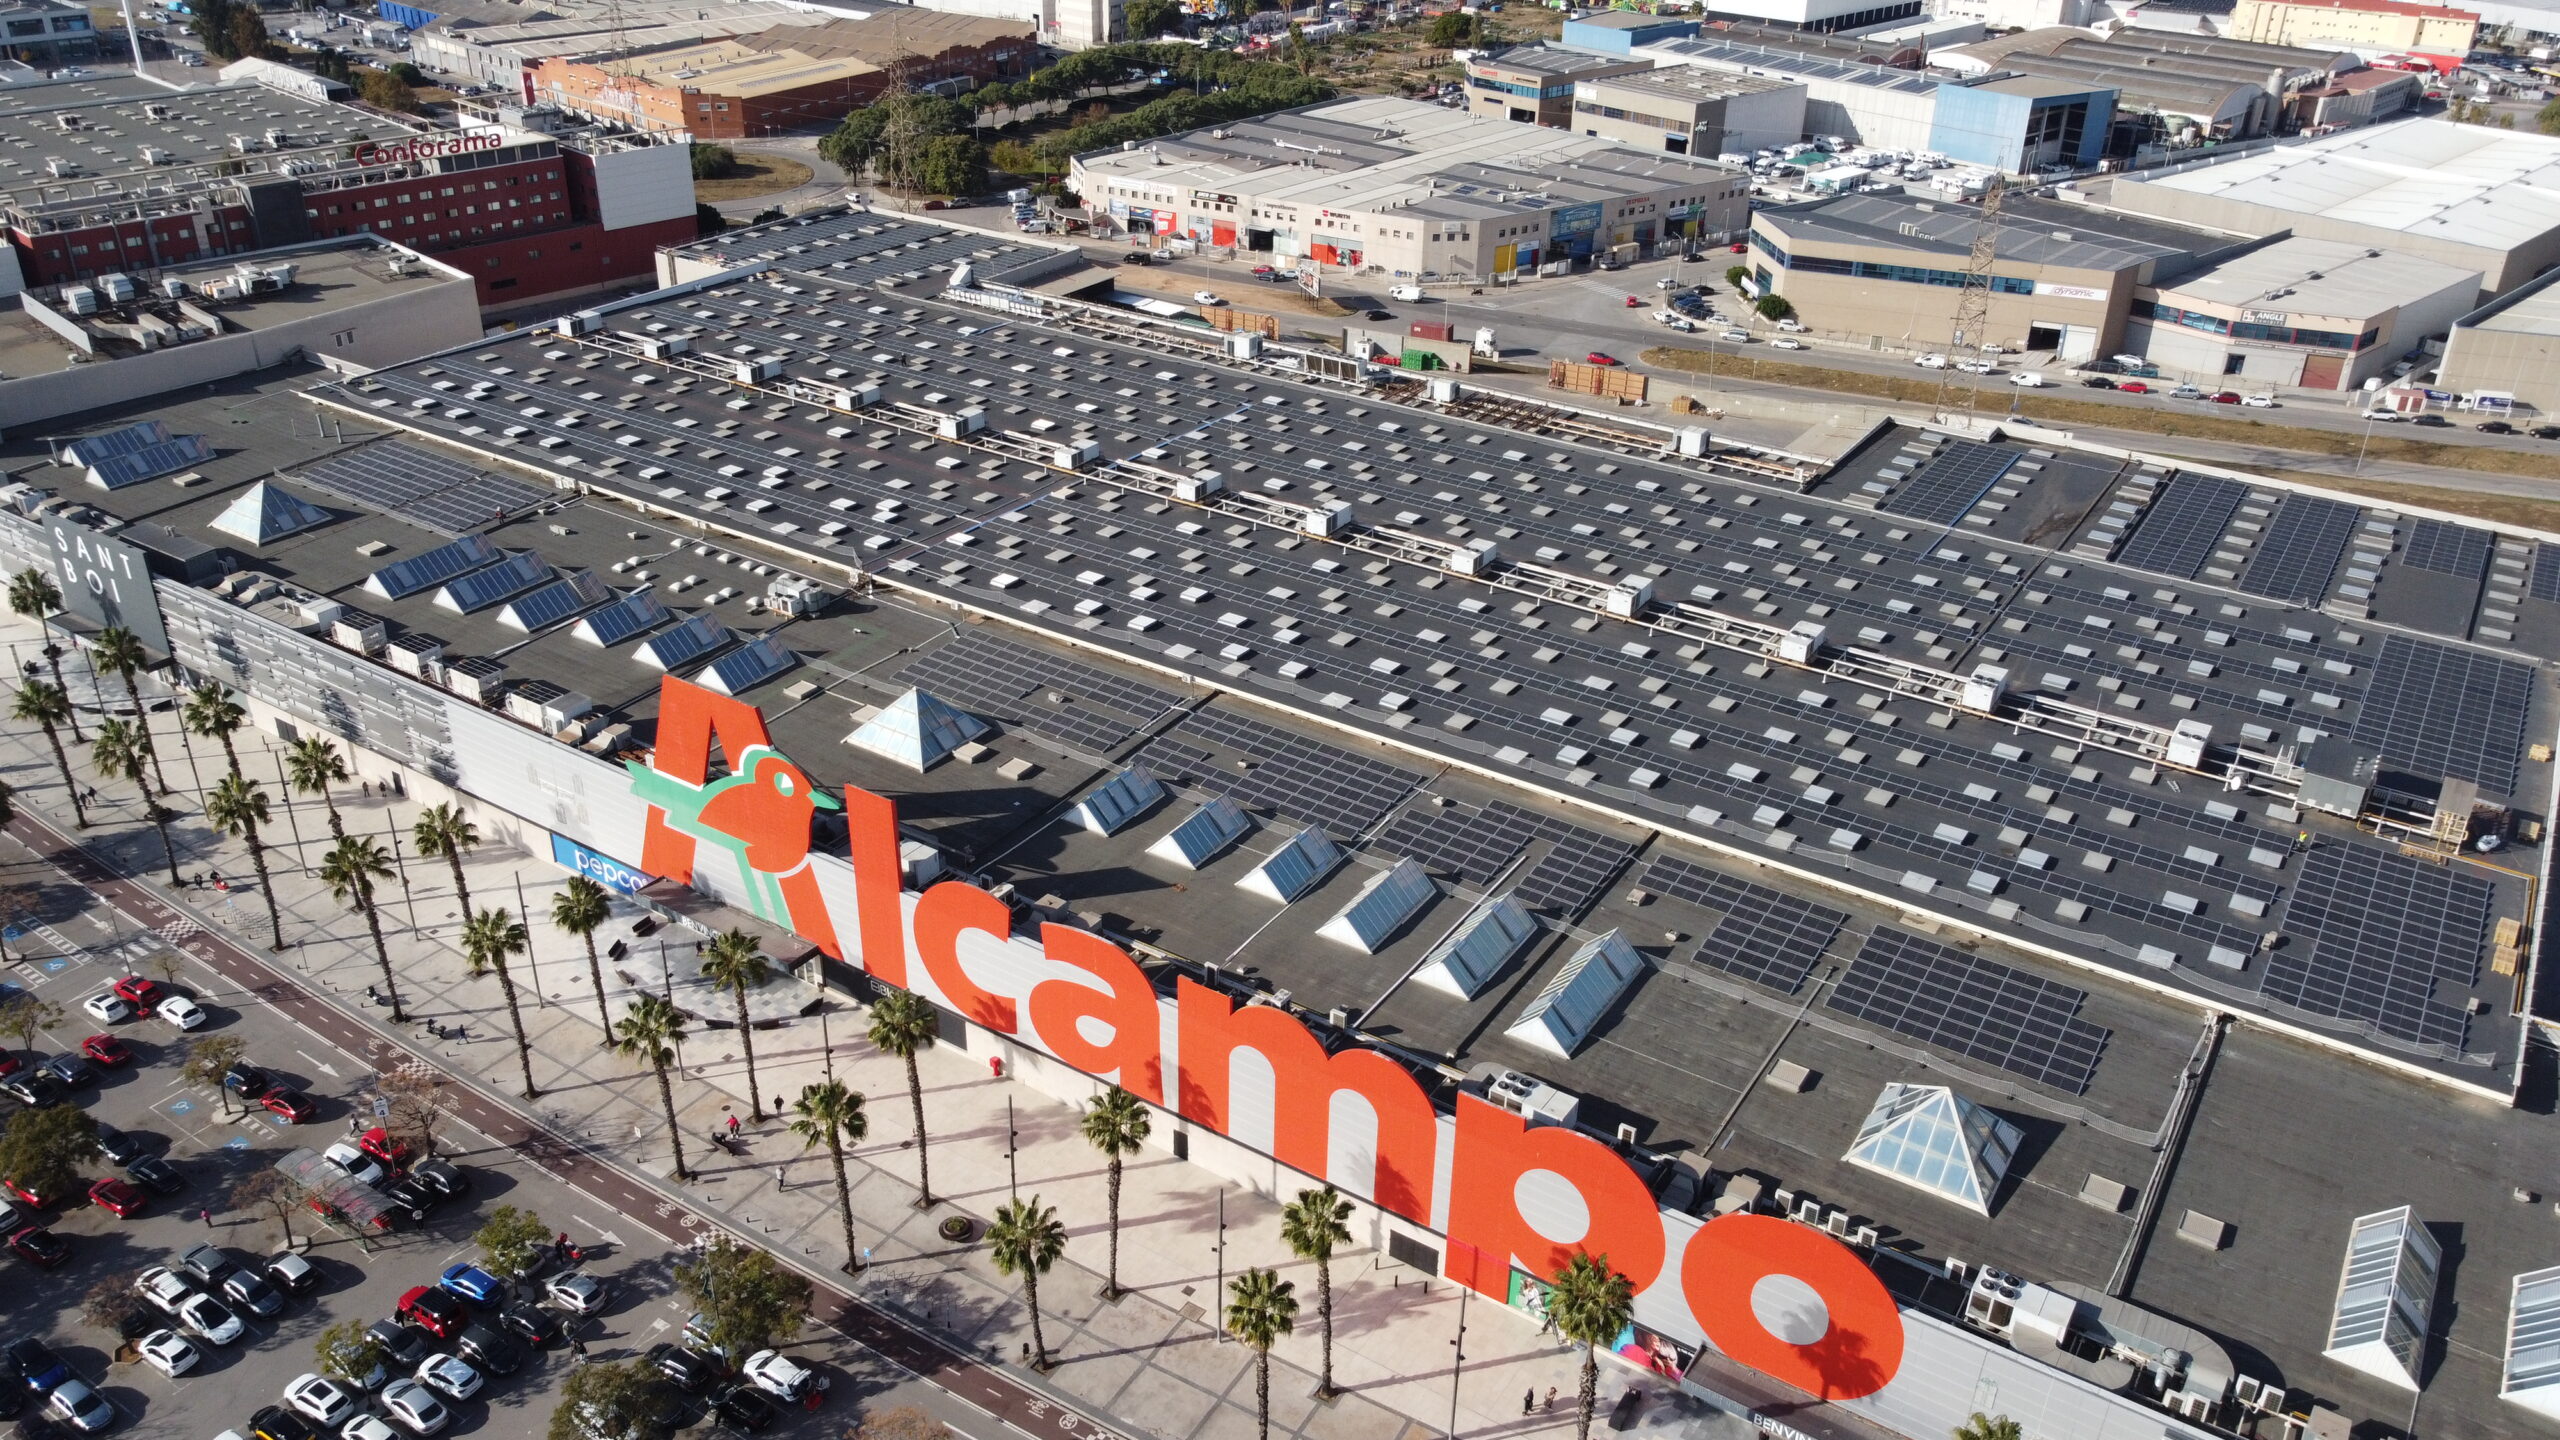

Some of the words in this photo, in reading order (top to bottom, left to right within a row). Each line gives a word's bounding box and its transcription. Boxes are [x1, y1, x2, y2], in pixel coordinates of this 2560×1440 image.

[355, 133, 502, 167] Conforama
[2256, 311, 2285, 321] ANGLE
[54, 526, 132, 580] SANT
[62, 557, 121, 603] BOI
[574, 849, 645, 892] pepco
[640, 674, 1905, 1401] Alcampo
[1062, 1414, 1076, 1427] 20
